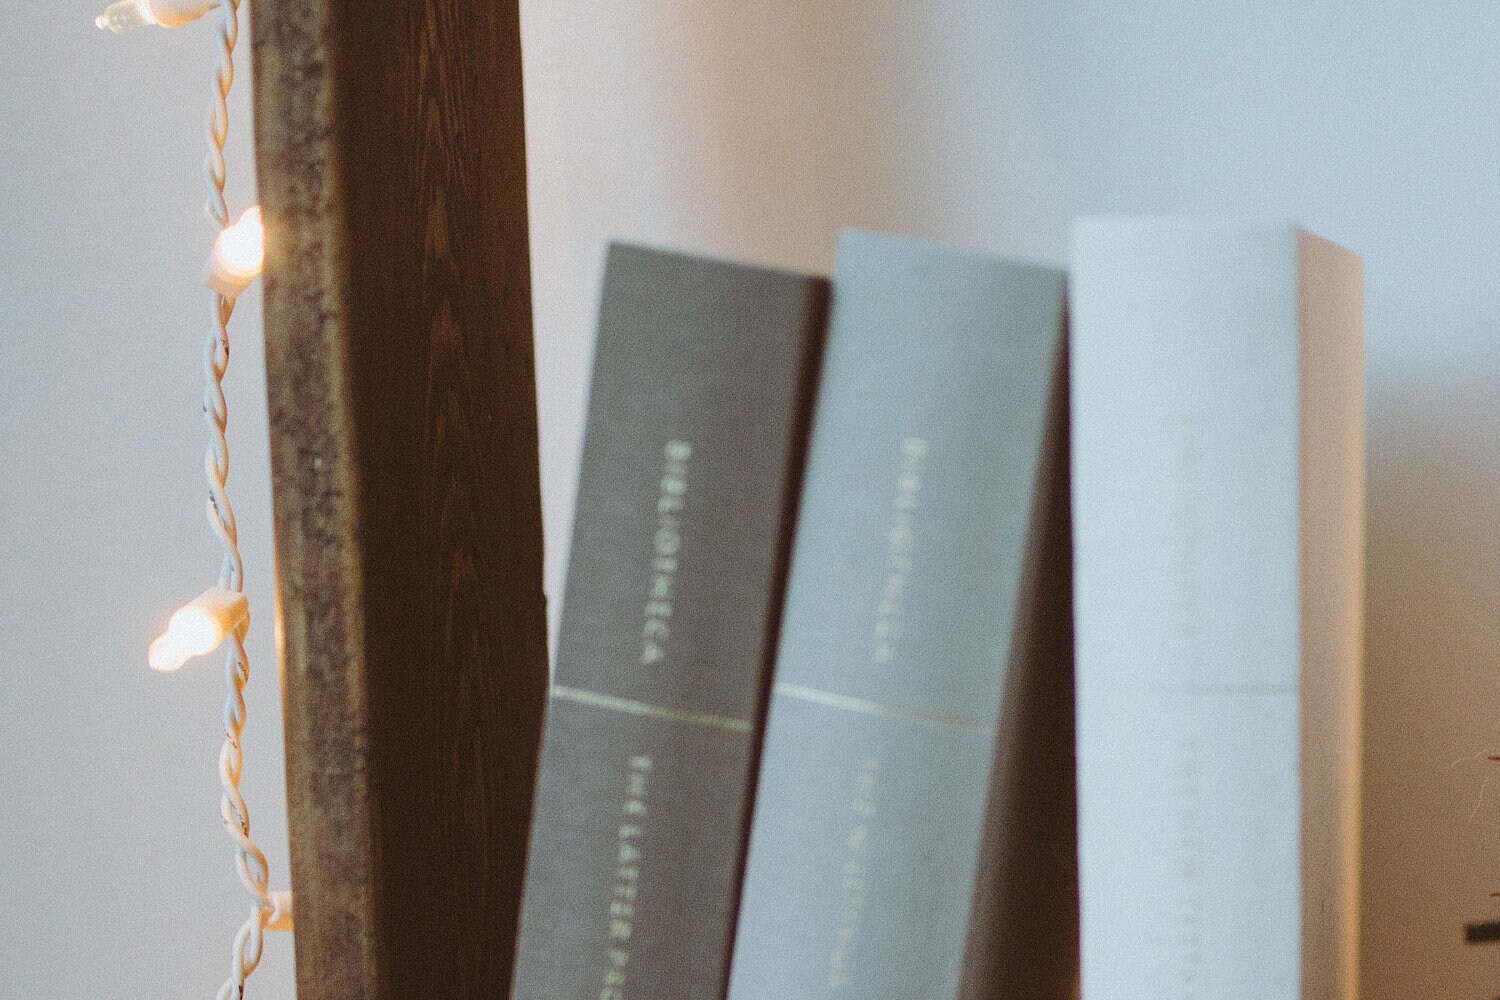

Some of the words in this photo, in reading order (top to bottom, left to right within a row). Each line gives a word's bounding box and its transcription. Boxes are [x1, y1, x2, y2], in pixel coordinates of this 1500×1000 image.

[640, 438, 693, 666] BIBLIOTHECA
[622, 755, 653, 816] THE
[608, 823, 643, 941] LATTER
